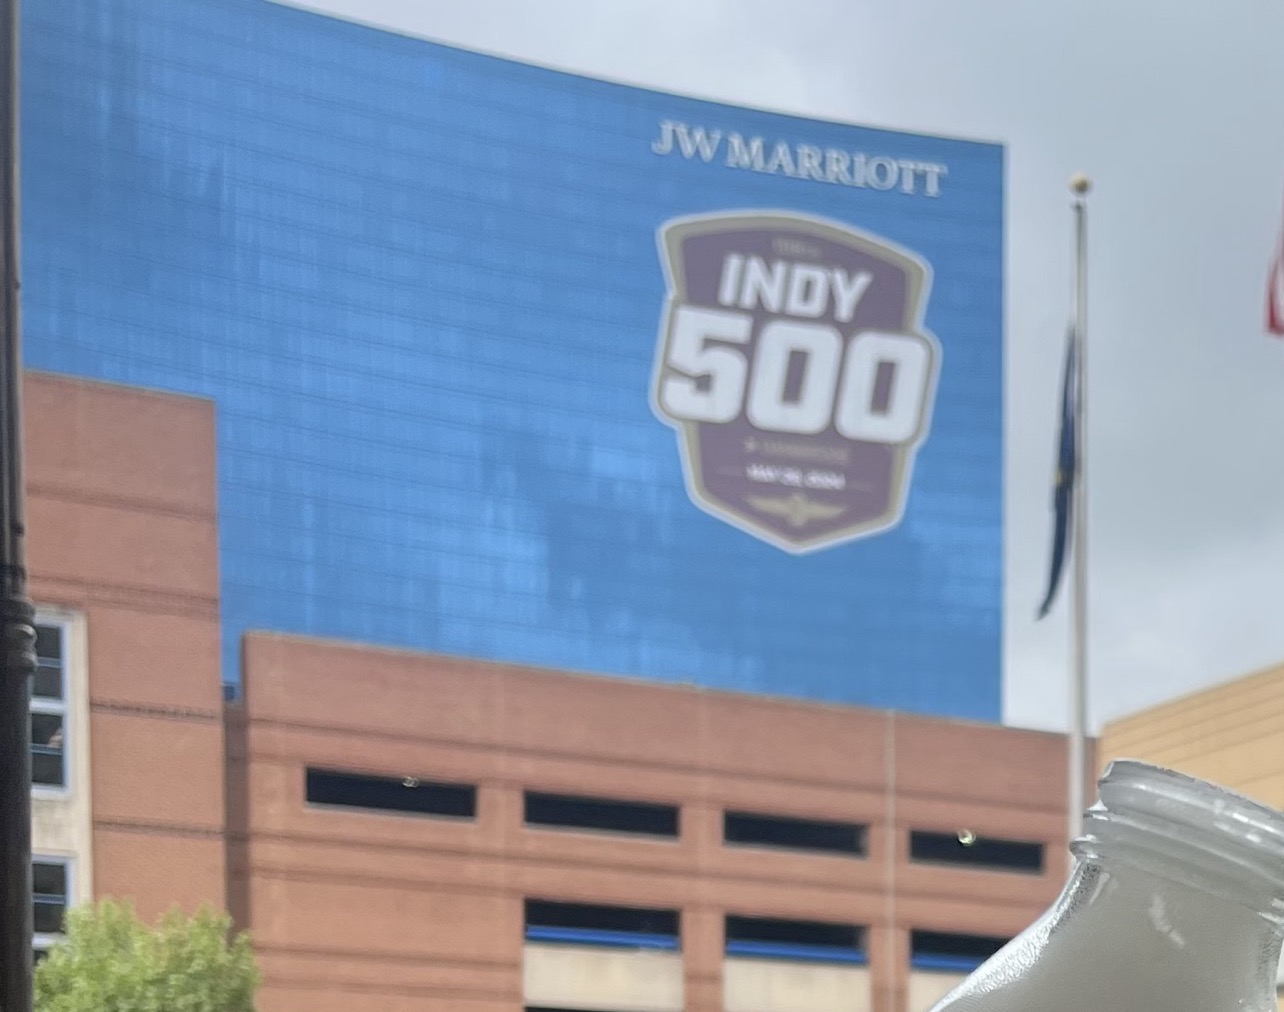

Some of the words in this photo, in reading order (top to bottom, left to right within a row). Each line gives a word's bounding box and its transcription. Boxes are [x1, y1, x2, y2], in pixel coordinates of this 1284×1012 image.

[652, 119, 722, 164] JW
[725, 131, 949, 198] MARRIOTT
[719, 254, 872, 322] INDY
[663, 305, 932, 444] 500
